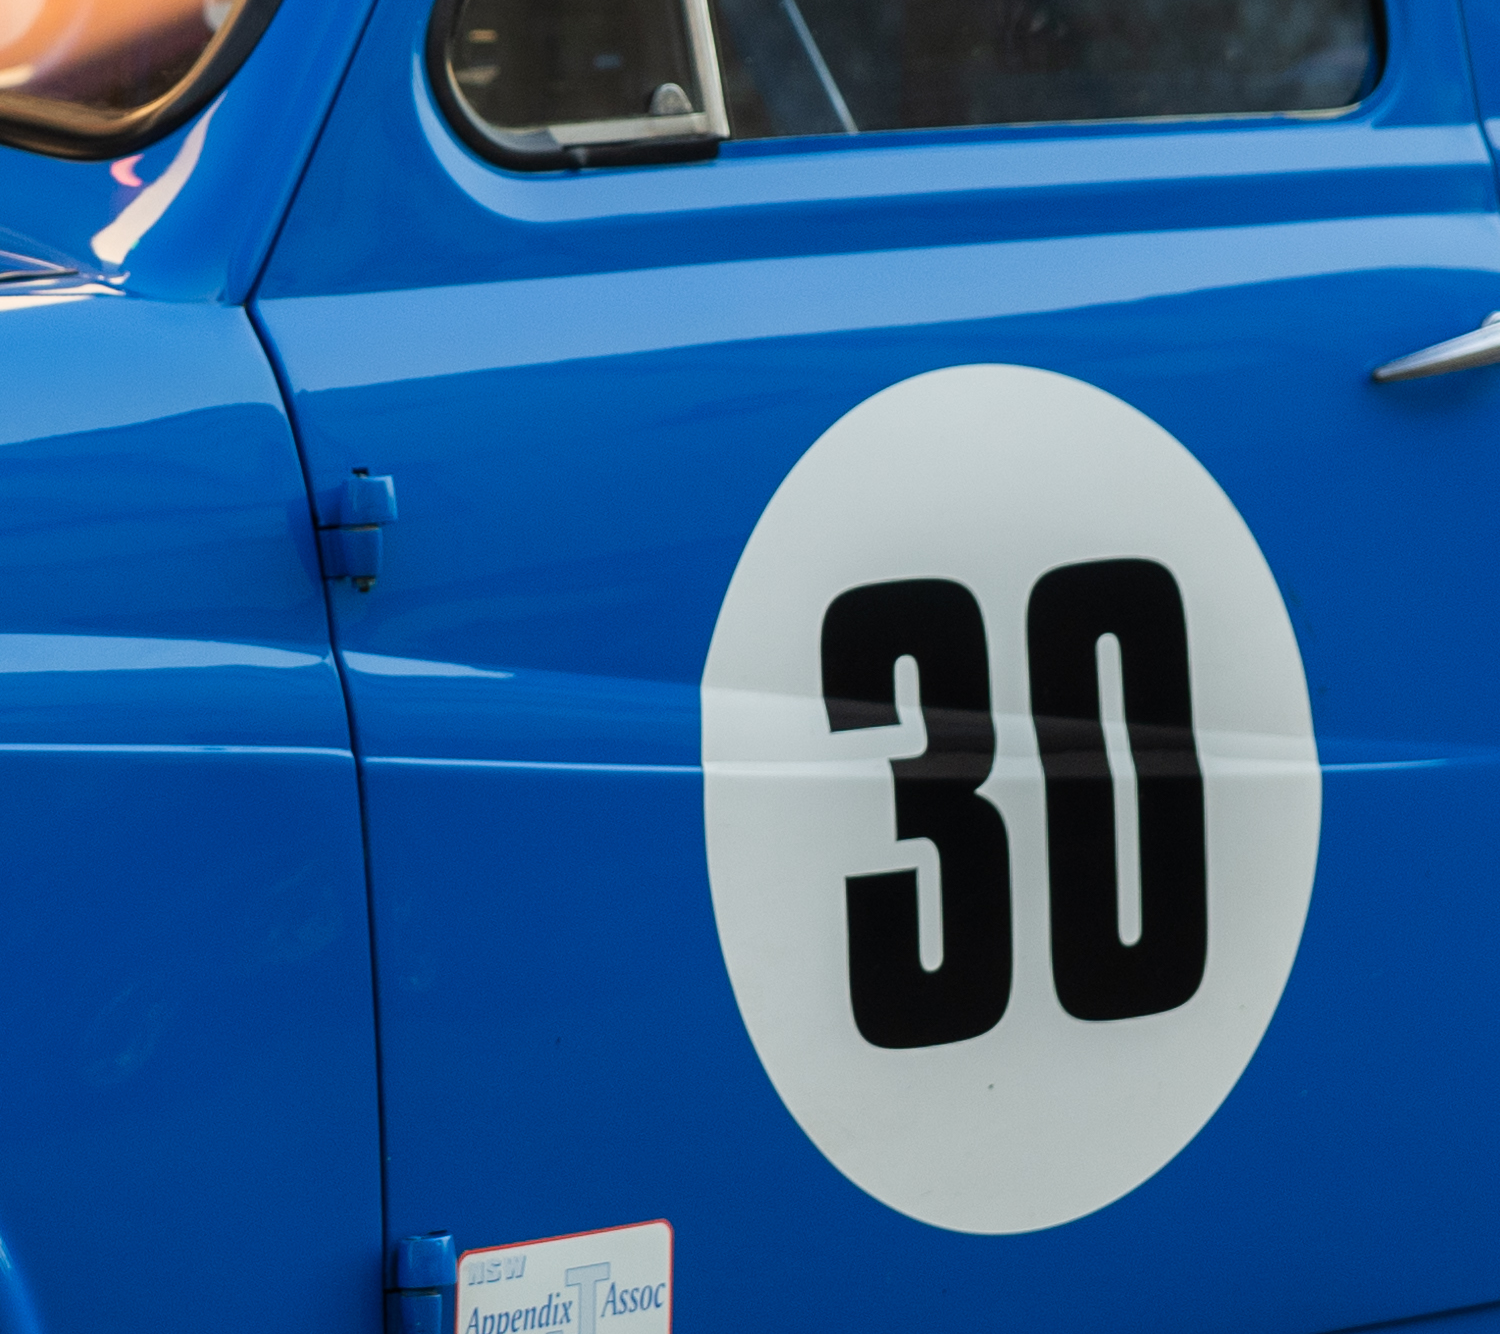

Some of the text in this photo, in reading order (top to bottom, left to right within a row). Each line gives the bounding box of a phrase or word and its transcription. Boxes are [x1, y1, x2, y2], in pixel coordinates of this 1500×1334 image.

[821, 556, 1208, 1050] 30
[467, 1255, 527, 1286] NSW
[600, 1282, 666, 1317] Assoc
